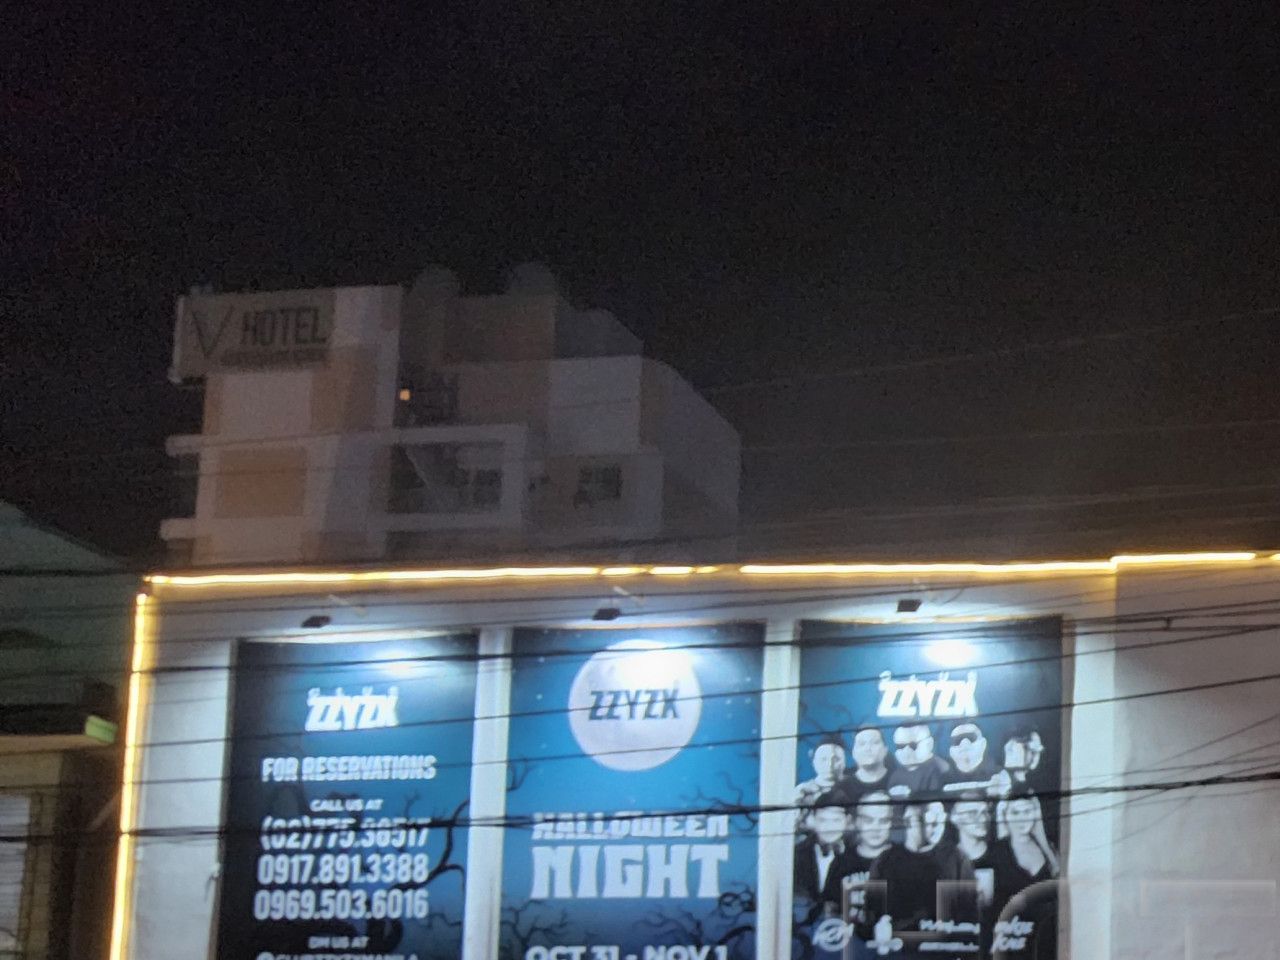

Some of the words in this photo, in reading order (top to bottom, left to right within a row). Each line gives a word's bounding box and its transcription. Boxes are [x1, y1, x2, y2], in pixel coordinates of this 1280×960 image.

[191, 306, 235, 360] V
[241, 307, 327, 346] HOTEL
[304, 686, 399, 732] ZZYZX
[588, 683, 681, 721] ZZYZX
[877, 671, 979, 717] ZZYZX
[261, 757, 299, 782] FOR
[301, 754, 438, 781] RESERVATIONS
[309, 799, 344, 812] CALL
[531, 811, 729, 840] HALLOWEEN
[256, 853, 429, 884] 0917.891.3388
[530, 844, 729, 898] NIGHT
[253, 889, 429, 920] 0969.503.6016
